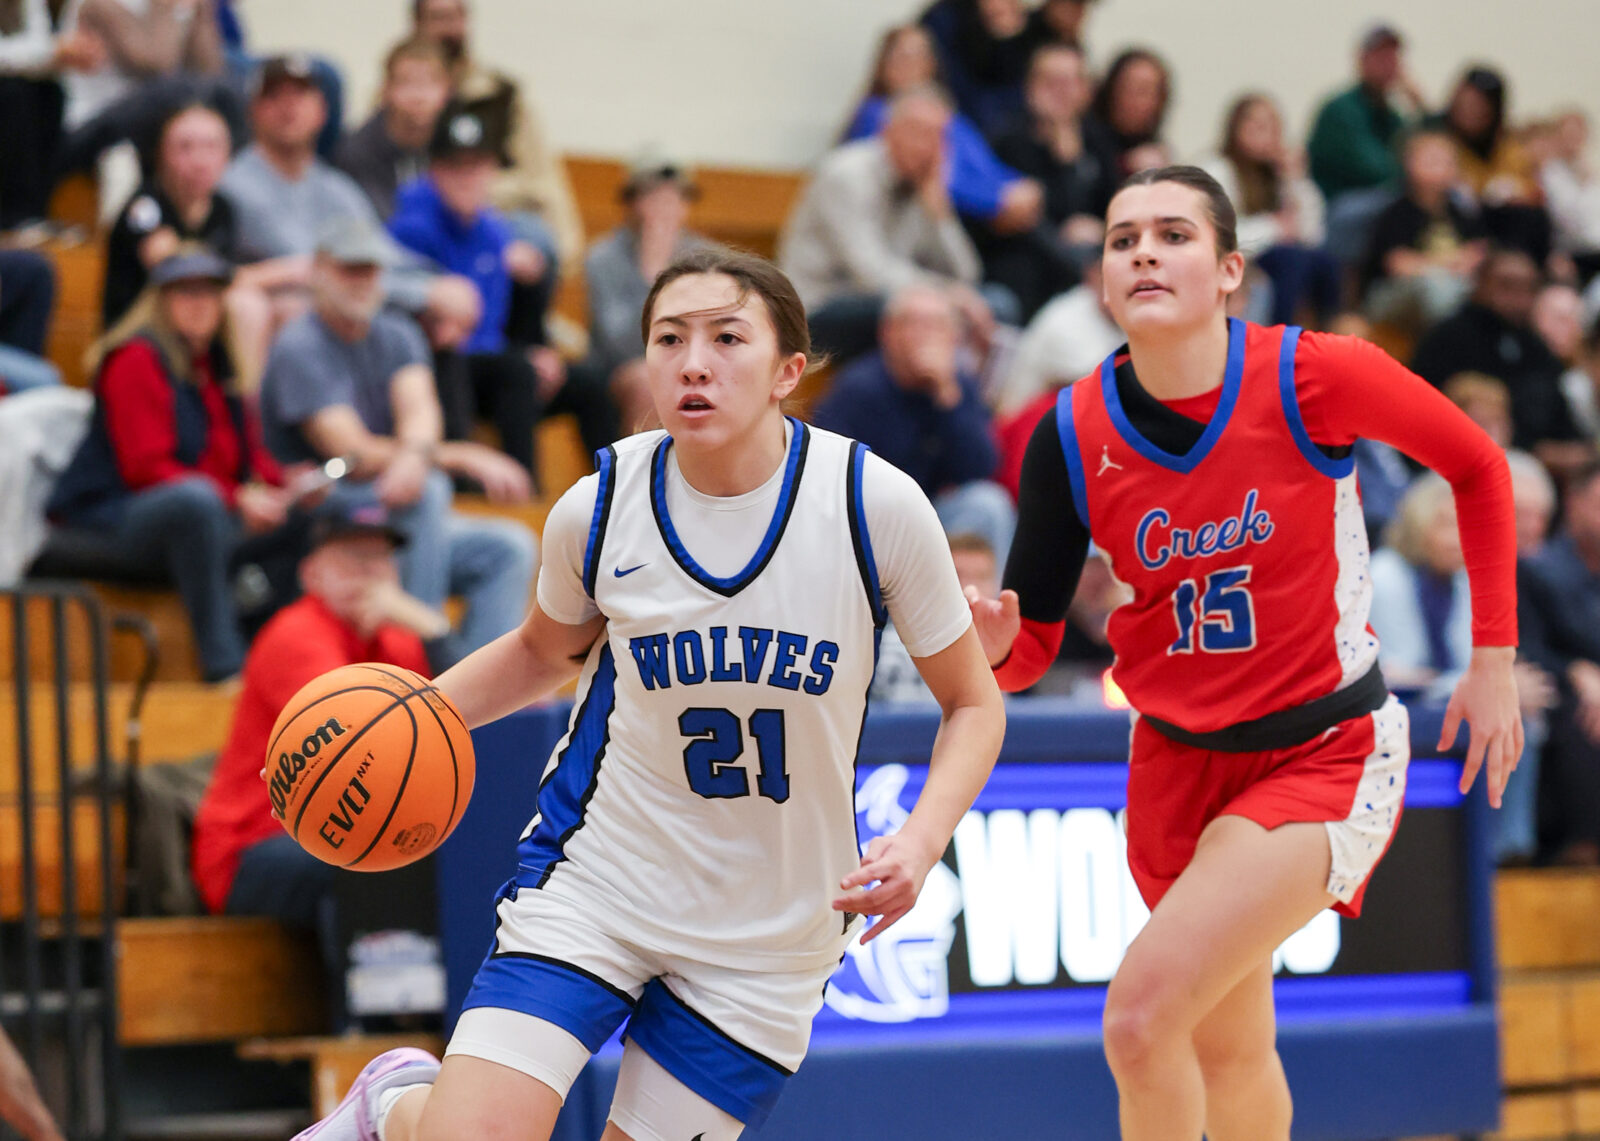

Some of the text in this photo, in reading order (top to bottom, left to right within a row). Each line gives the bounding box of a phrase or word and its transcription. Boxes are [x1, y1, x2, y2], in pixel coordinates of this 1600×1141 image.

[1135, 488, 1275, 571] Creek
[1166, 564, 1257, 656] 15
[629, 625, 840, 696] WOLVES
[270, 718, 347, 820] Wilson
[677, 707, 790, 804] 21
